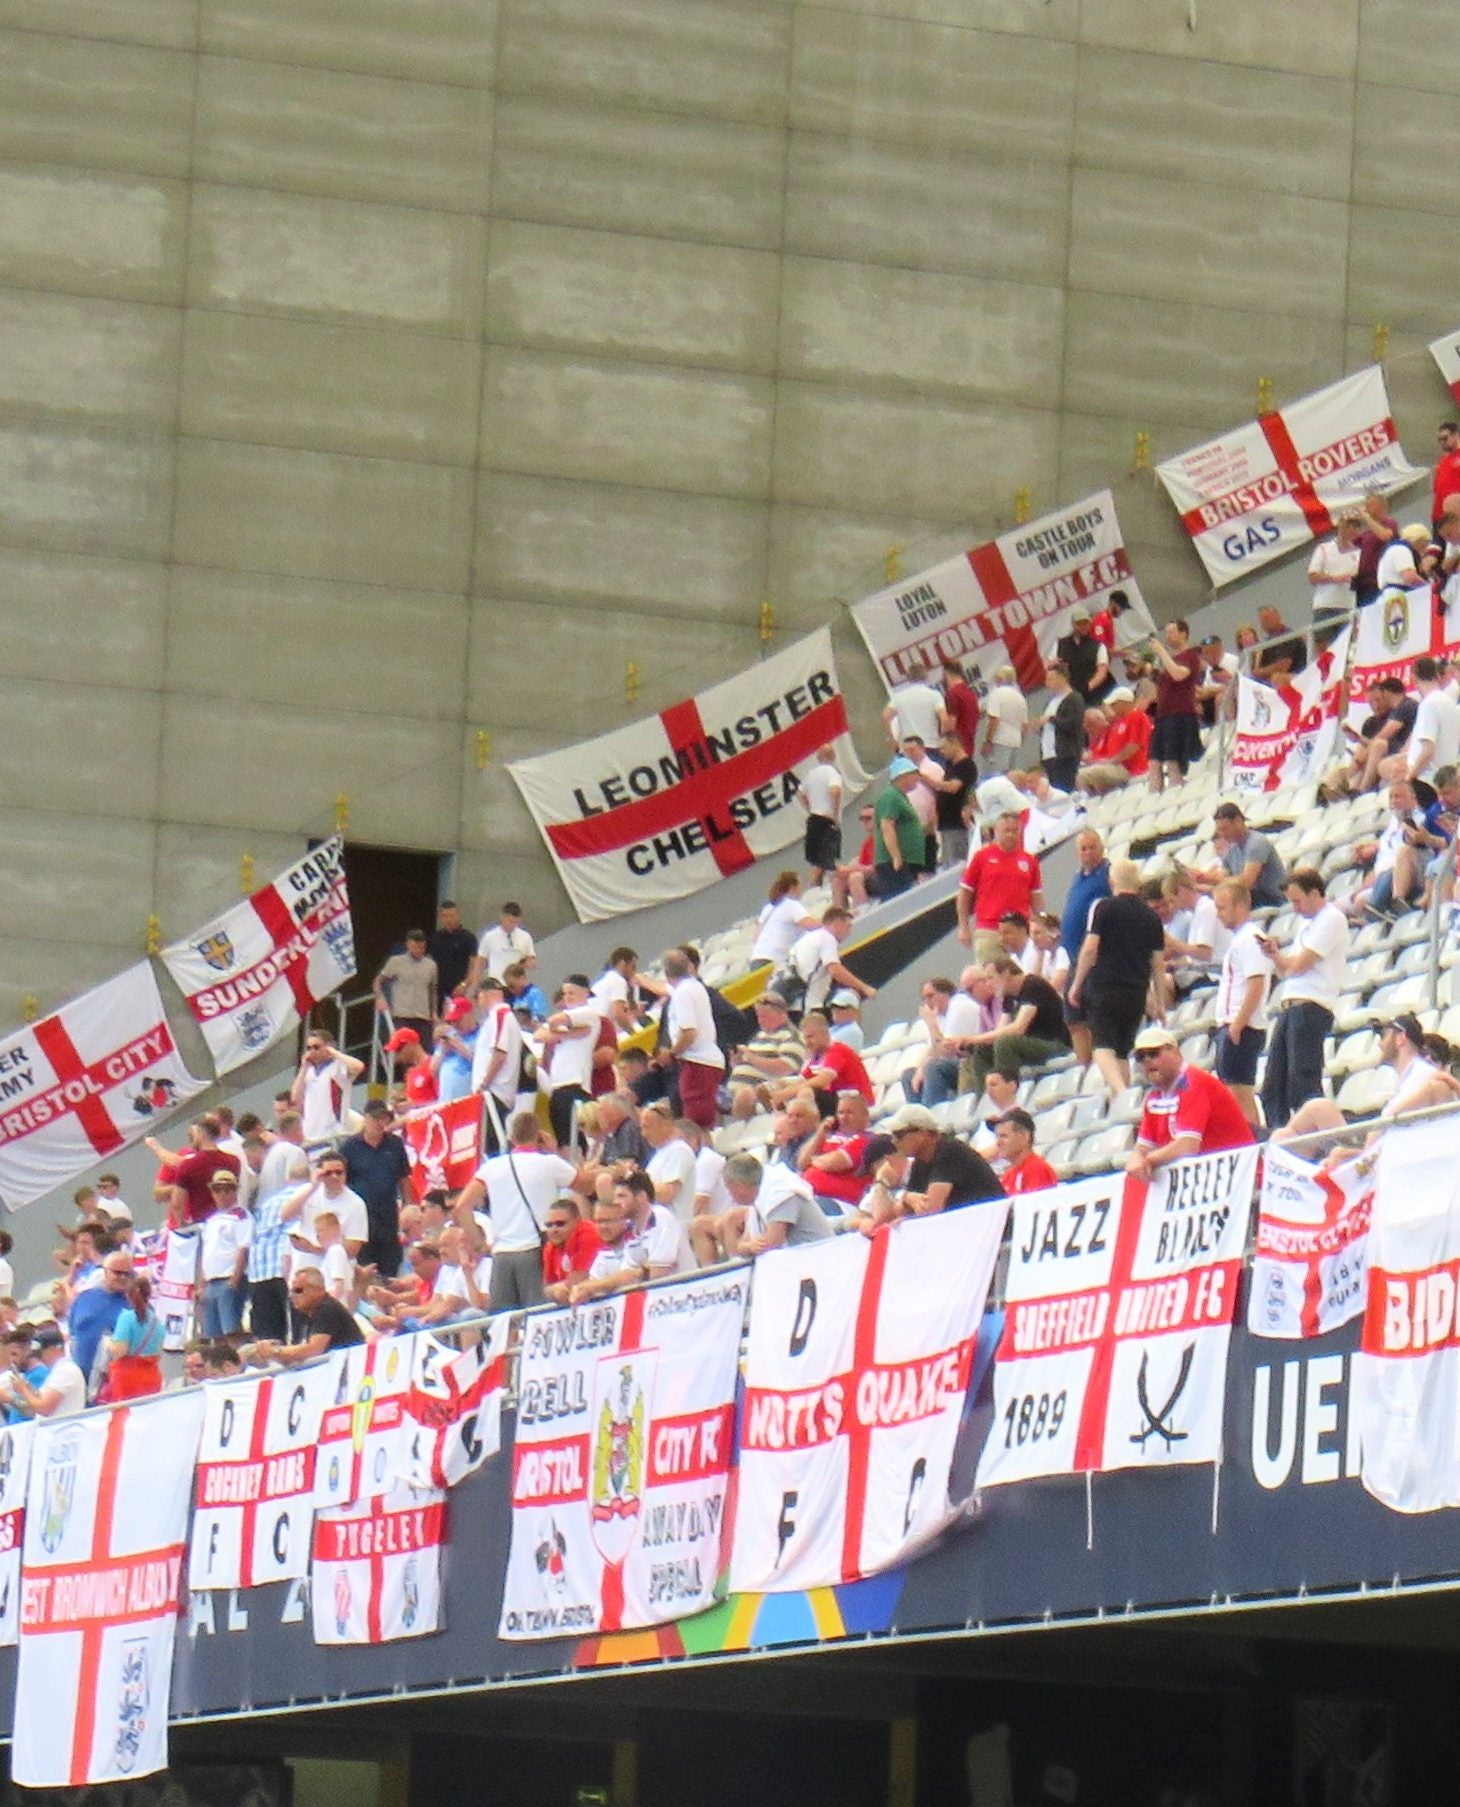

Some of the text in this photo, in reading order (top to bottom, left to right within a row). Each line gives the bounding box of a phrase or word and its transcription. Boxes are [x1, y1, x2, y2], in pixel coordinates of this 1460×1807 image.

[1200, 471, 1298, 528] BRISTOL
[1297, 424, 1390, 482] ROVERS
[1015, 507, 1104, 559] CASTLE BOYS
[1038, 532, 1097, 570] ON TOUR
[1223, 516, 1281, 562] GAS
[894, 582, 938, 610] LOYAL
[901, 600, 947, 632] LUTON
[881, 615, 986, 685] LUTON
[986, 573, 1077, 638] TOWN
[573, 669, 837, 818] LEOMINSTER
[626, 772, 802, 877] CHELSEA
[105, 1031, 165, 1078] CITY
[1165, 1153, 1241, 1212] HEELEY
[1020, 1198, 1112, 1264] JAZZ
[789, 1277, 818, 1358] D
[1014, 1268, 1224, 1353] SHEFFIELD UNITED FC
[220, 1399, 235, 1449] D
[287, 1385, 306, 1437] C
[748, 1382, 845, 1448] NOTTS
[1003, 1390, 1068, 1450] 1889
[654, 1424, 698, 1476] CITY
[272, 1511, 291, 1565] C
[774, 1491, 798, 1570] F
